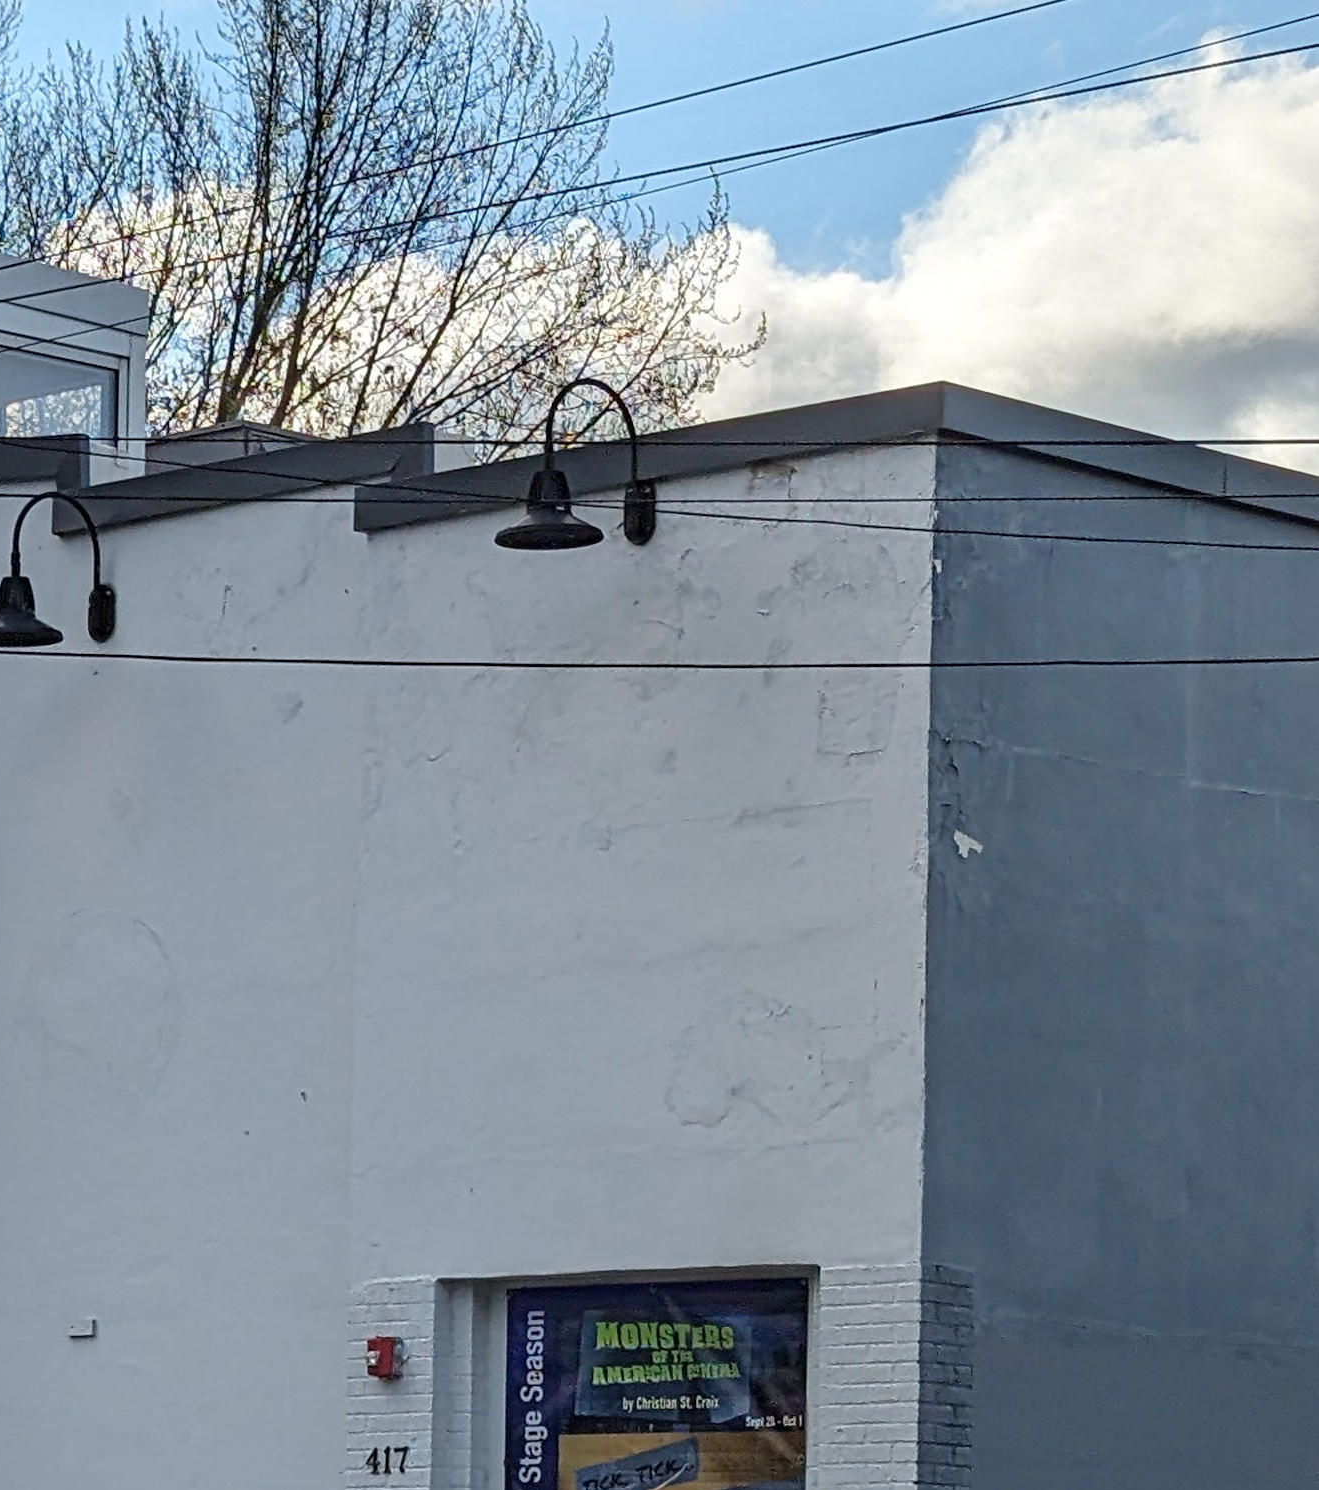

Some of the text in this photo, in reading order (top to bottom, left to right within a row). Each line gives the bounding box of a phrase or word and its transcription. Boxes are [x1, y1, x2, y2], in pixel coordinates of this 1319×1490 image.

[596, 1321, 734, 1350] MONSTERS
[520, 1309, 546, 1402] Season
[652, 1350, 667, 1363] OF
[592, 1363, 684, 1385] AMERICAN
[622, 1397, 634, 1412] by
[636, 1396, 677, 1410] Christian
[695, 1395, 719, 1409] Croix
[745, 1415, 764, 1429] Sept
[782, 1415, 796, 1427] Oct
[519, 1410, 548, 1483] Stage
[365, 1446, 409, 1475] 417
